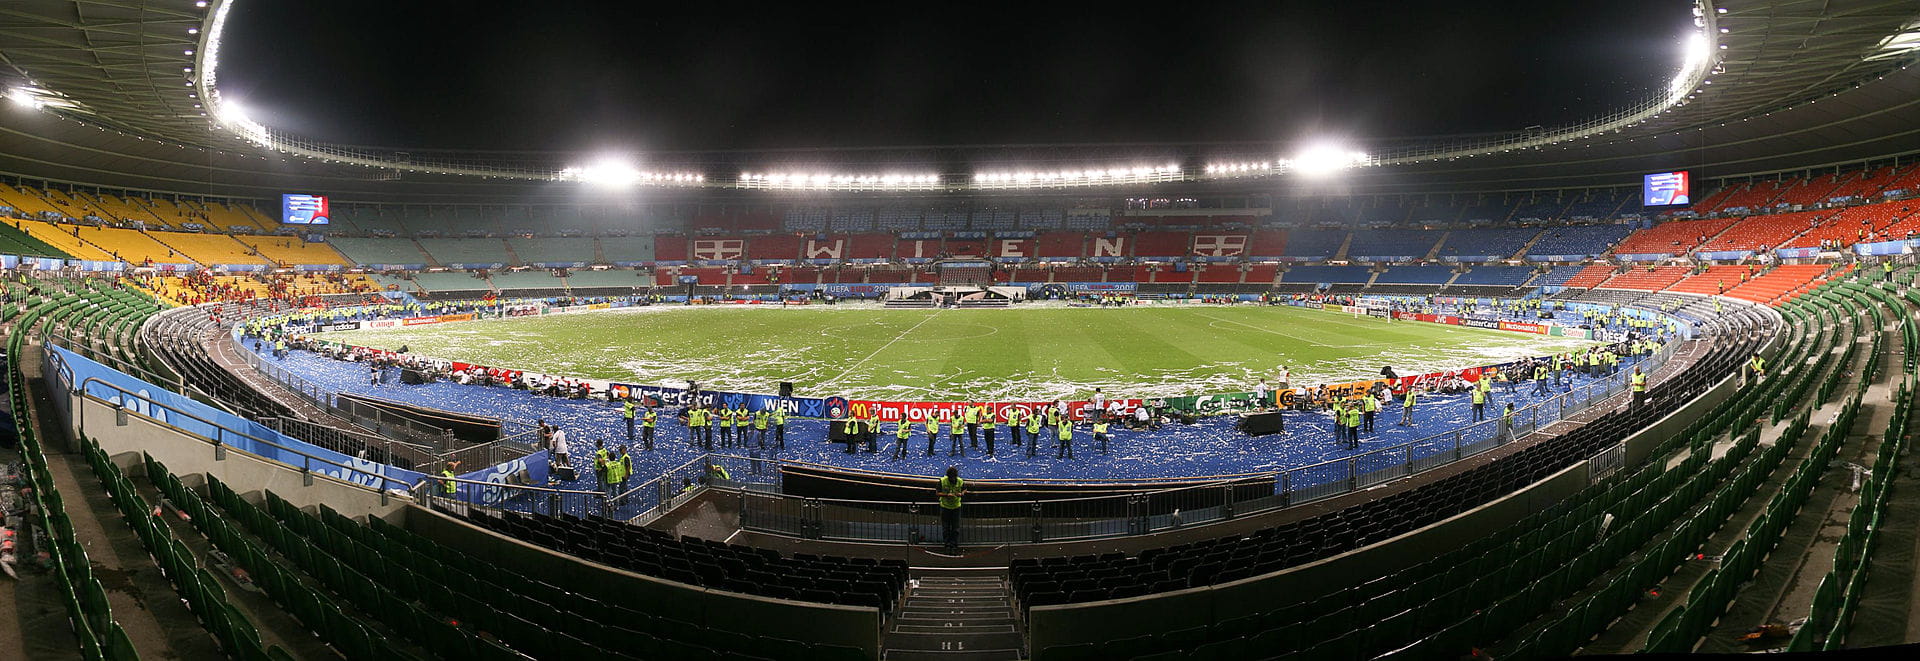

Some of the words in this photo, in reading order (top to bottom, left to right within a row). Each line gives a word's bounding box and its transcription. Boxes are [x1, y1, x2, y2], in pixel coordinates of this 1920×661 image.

[874, 285, 890, 293] 200
[1435, 315, 1447, 324] JVC
[370, 321, 395, 329] Canon
[764, 398, 799, 416] WIEN
